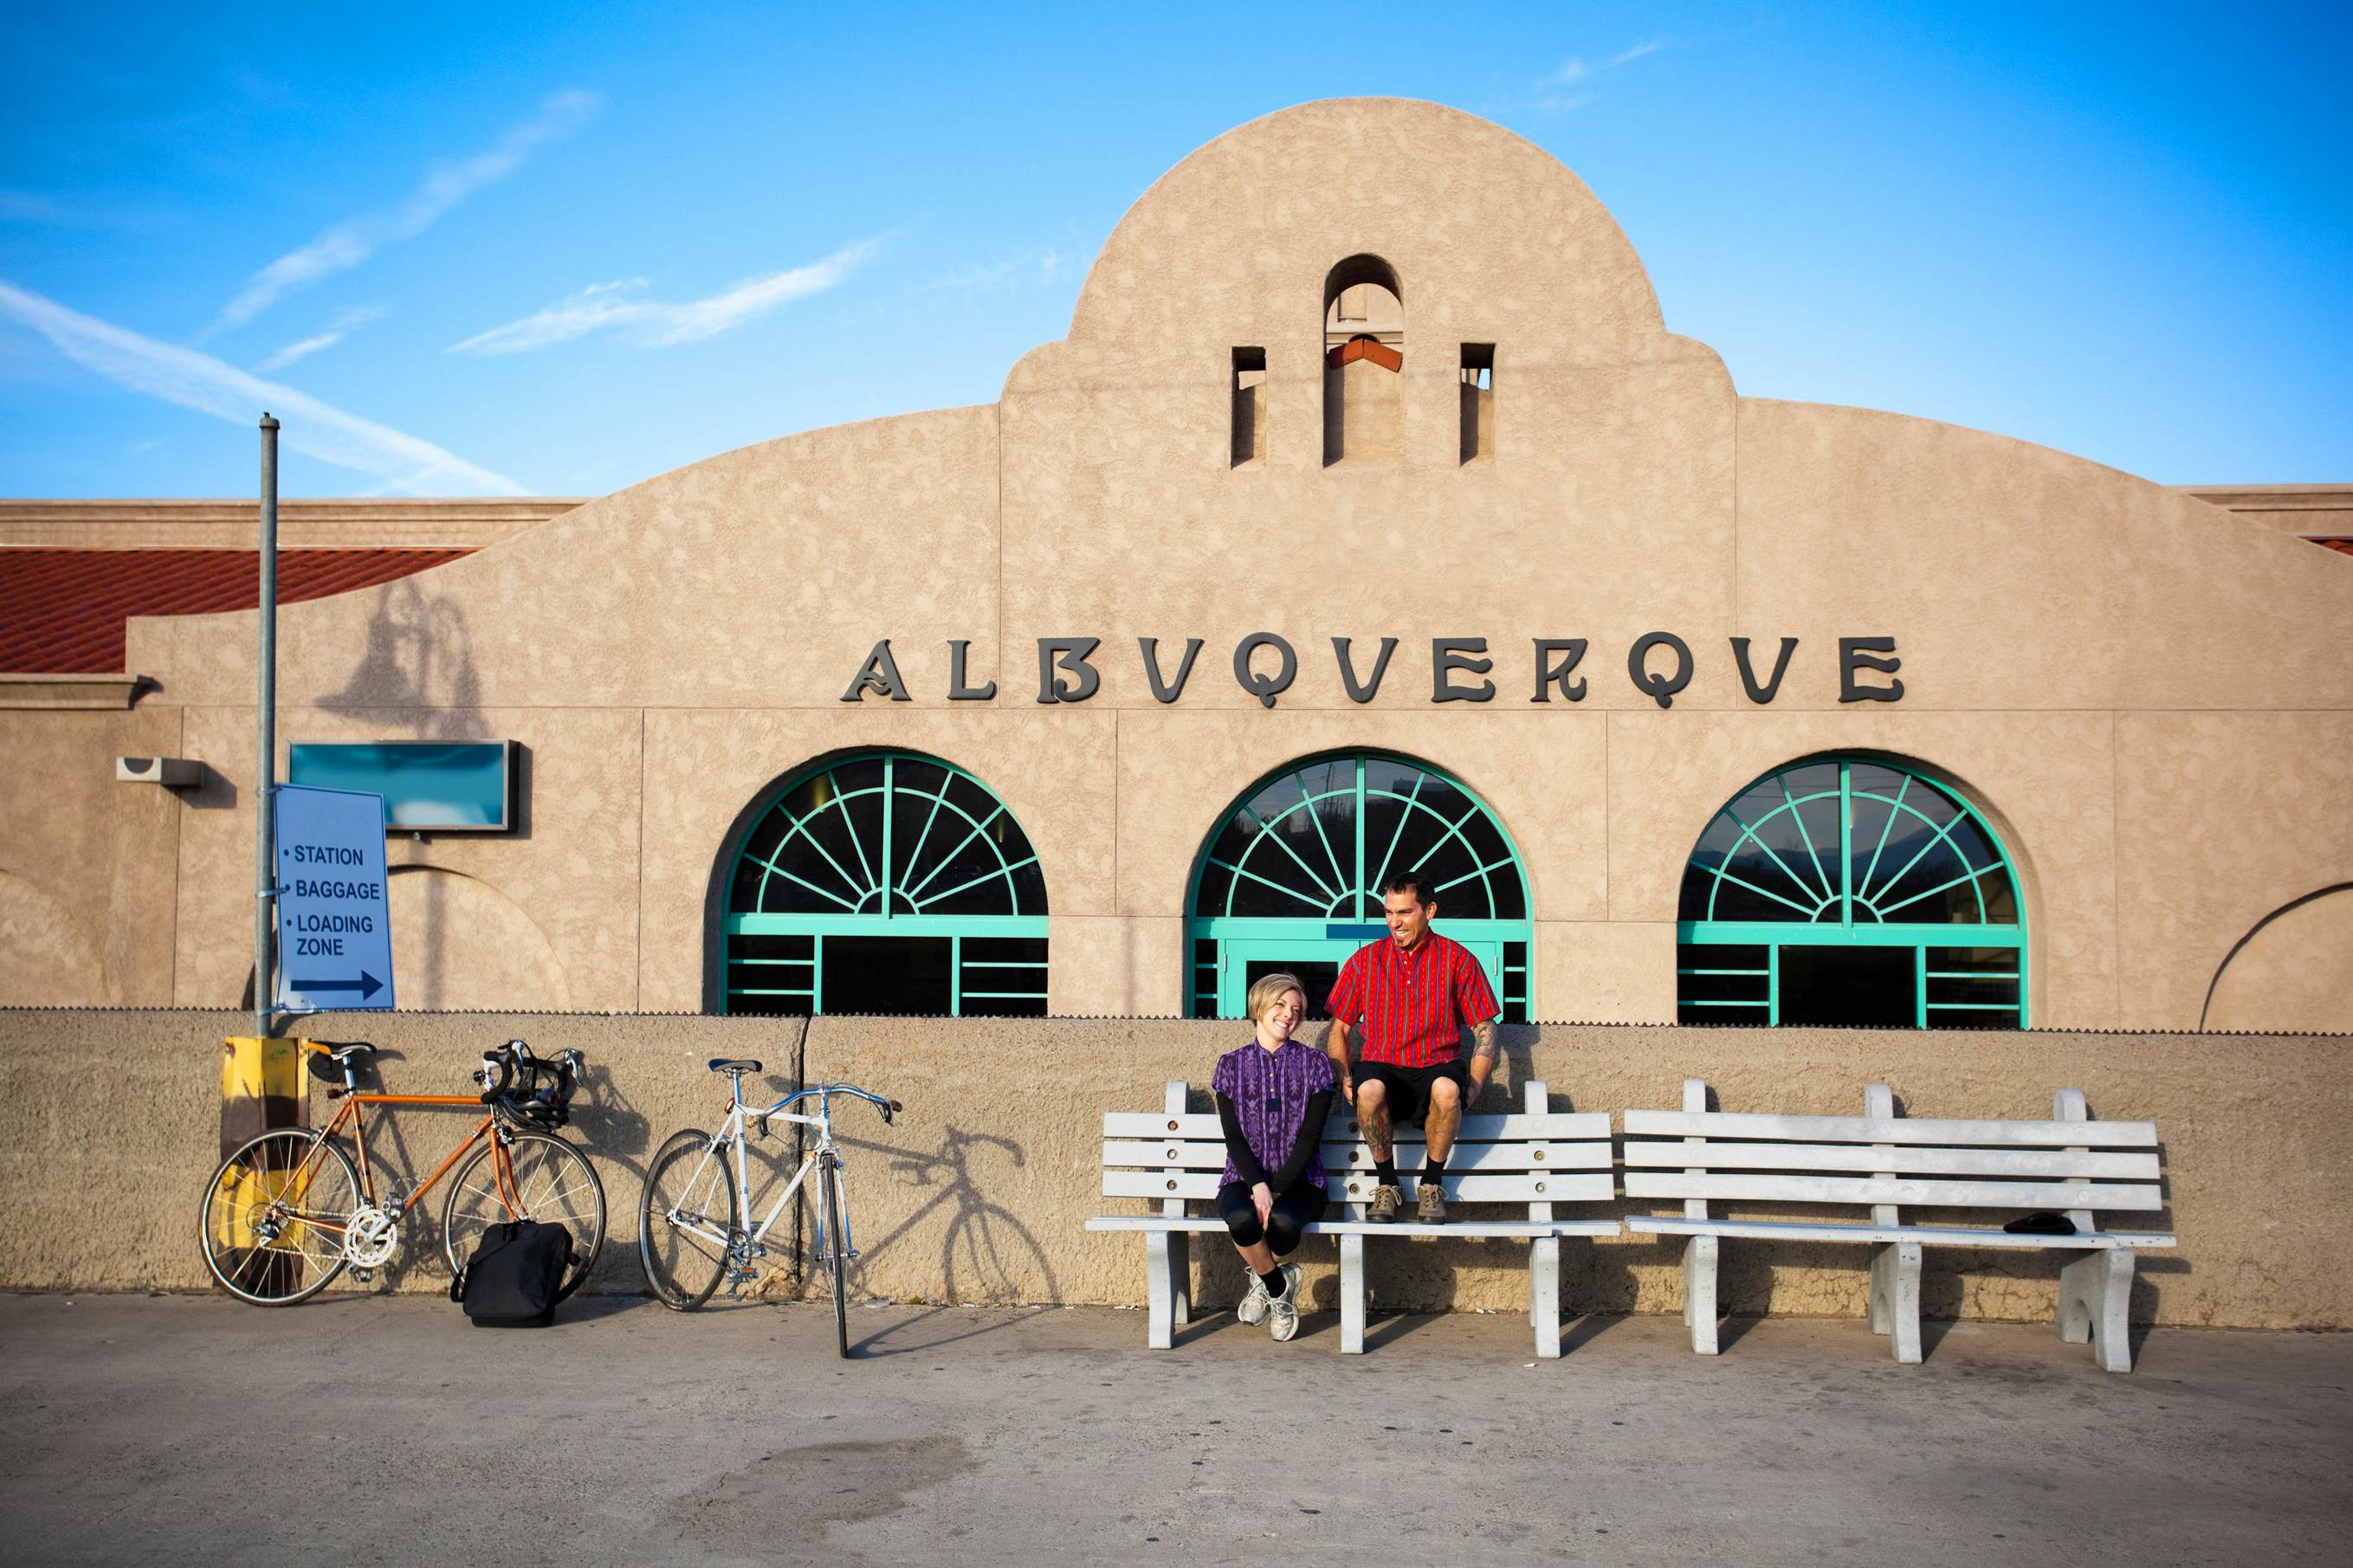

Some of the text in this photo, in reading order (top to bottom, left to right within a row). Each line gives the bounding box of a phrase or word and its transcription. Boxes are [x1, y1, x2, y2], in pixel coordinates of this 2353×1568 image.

[294, 845, 363, 865] STATION
[296, 880, 379, 900] BAGGAGE
[298, 914, 372, 932] LOADING
[297, 939, 344, 955] ZONE
